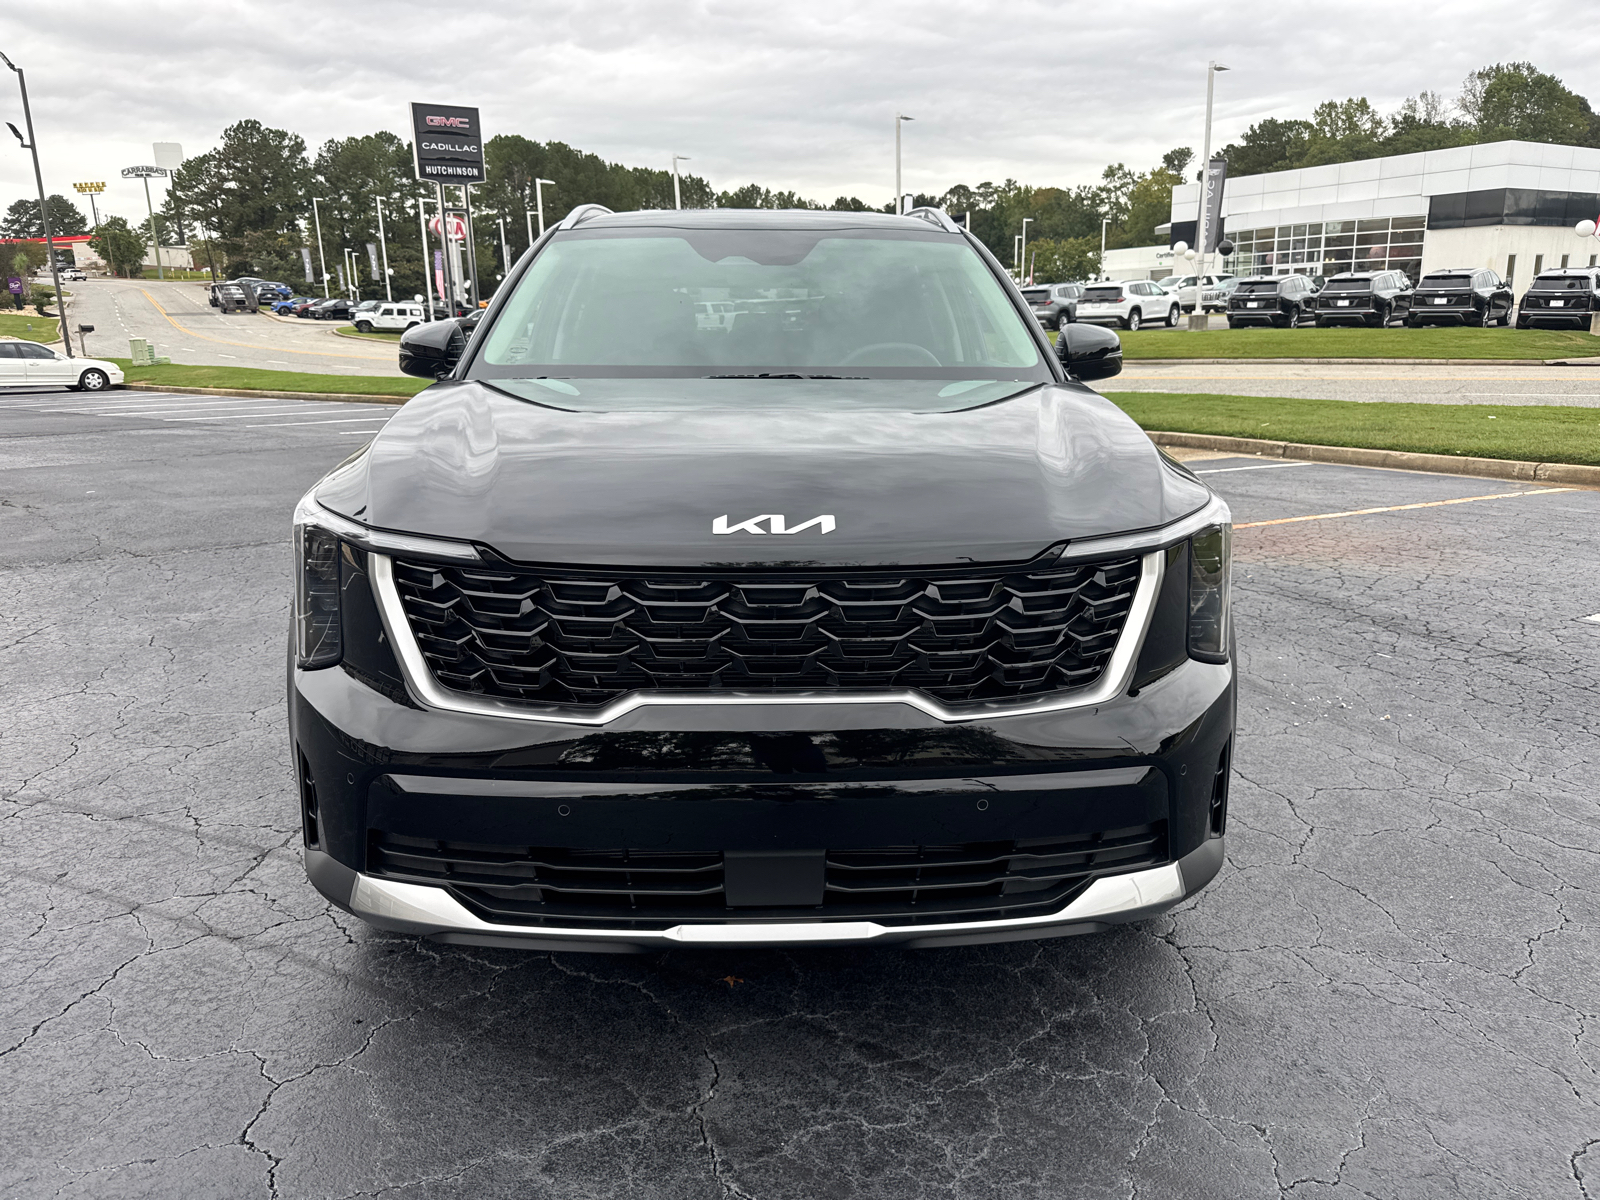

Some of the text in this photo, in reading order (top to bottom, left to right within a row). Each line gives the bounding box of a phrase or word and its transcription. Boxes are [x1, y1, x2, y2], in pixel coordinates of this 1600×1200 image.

[426, 116, 469, 128] GMC
[422, 142, 478, 152] CADILLAC
[426, 165, 478, 176] HUTCHINSON
[712, 514, 836, 535] KIA
